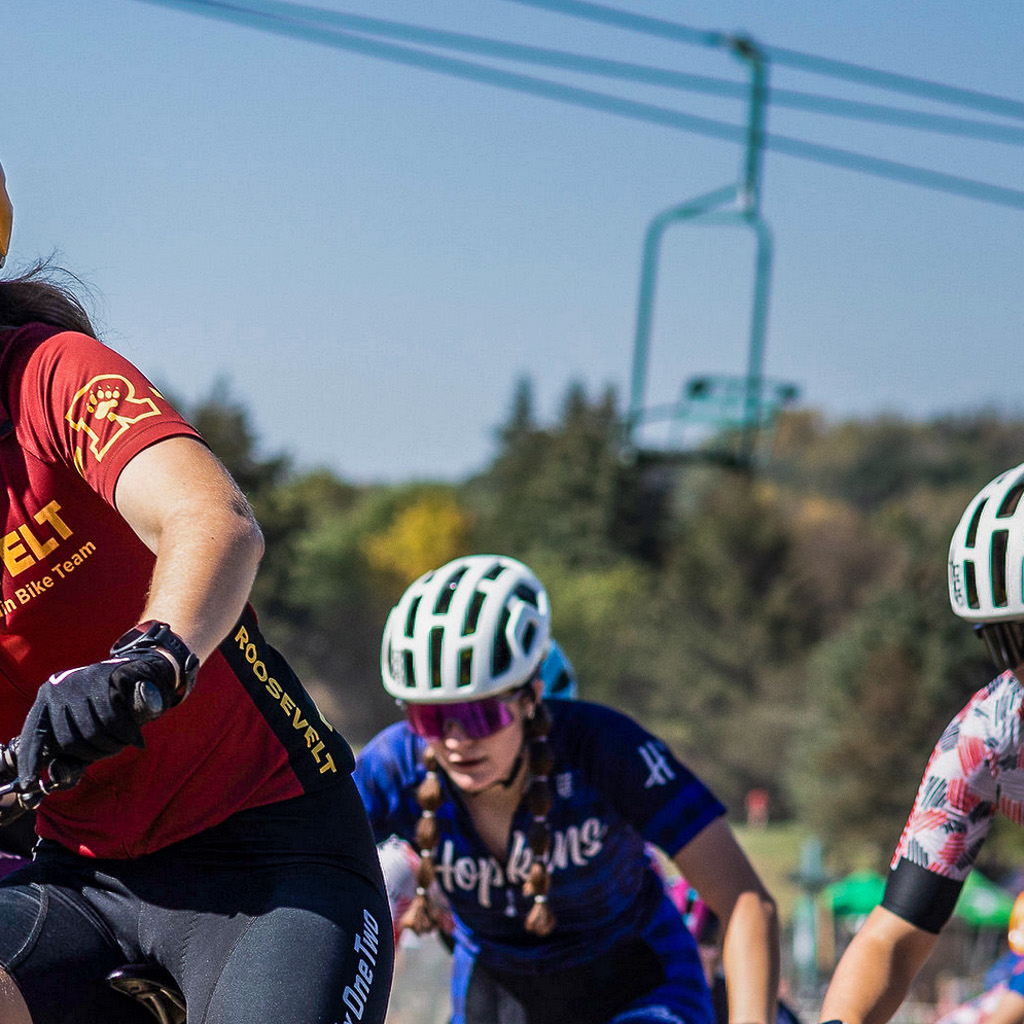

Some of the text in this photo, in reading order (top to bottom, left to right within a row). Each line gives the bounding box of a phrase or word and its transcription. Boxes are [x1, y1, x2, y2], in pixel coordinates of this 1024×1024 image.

[14, 575, 55, 605] Bike
[51, 541, 97, 579] Team
[234, 625, 337, 774] ROOSEVELT
